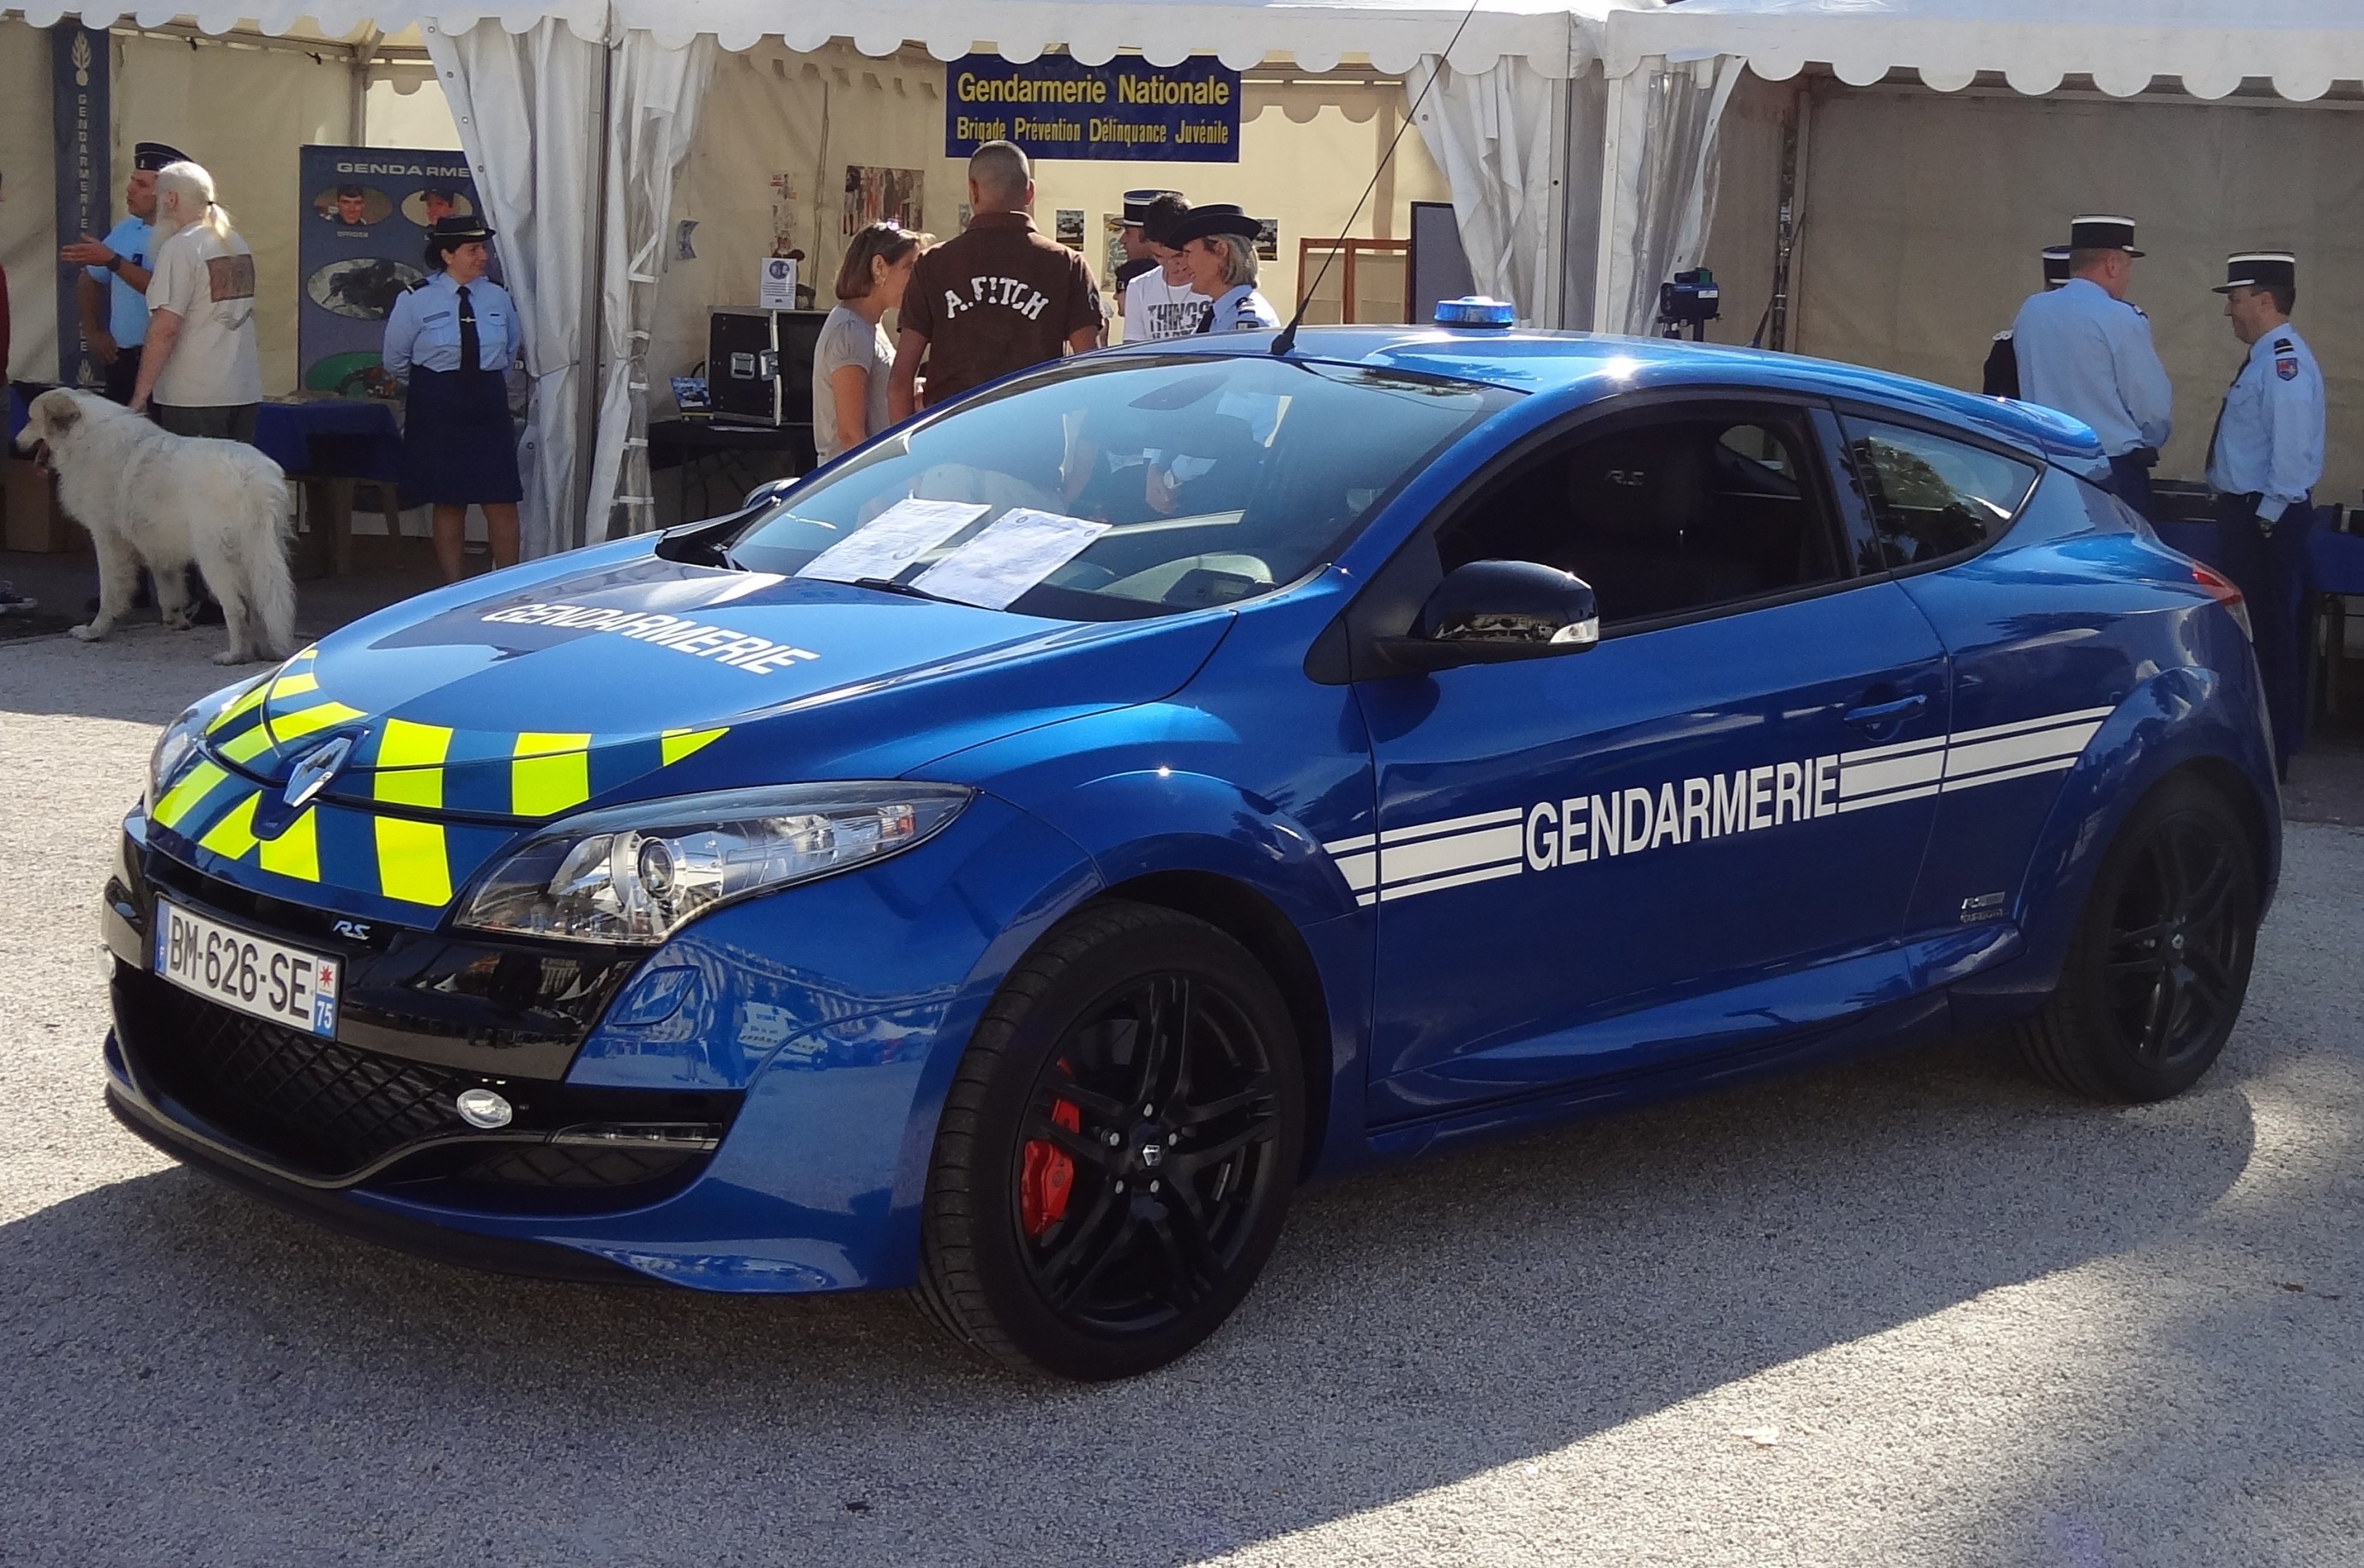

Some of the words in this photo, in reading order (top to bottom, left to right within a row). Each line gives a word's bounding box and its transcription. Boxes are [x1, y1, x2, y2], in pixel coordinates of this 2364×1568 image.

[957, 72, 1106, 103] Gendarmerie
[1119, 74, 1229, 105] Nationale
[78, 93, 89, 229] GENDARMERIE
[956, 117, 1006, 146] Brigade
[1014, 117, 1081, 142] Prévention
[1089, 118, 1167, 147] Délinquance
[1174, 118, 1228, 144] Juvénile
[480, 603, 821, 675] GENDARMERIE
[1526, 754, 1839, 871] GENDARMERIE
[170, 915, 312, 1020] BM-626-SE
[316, 1000, 333, 1029] 75
